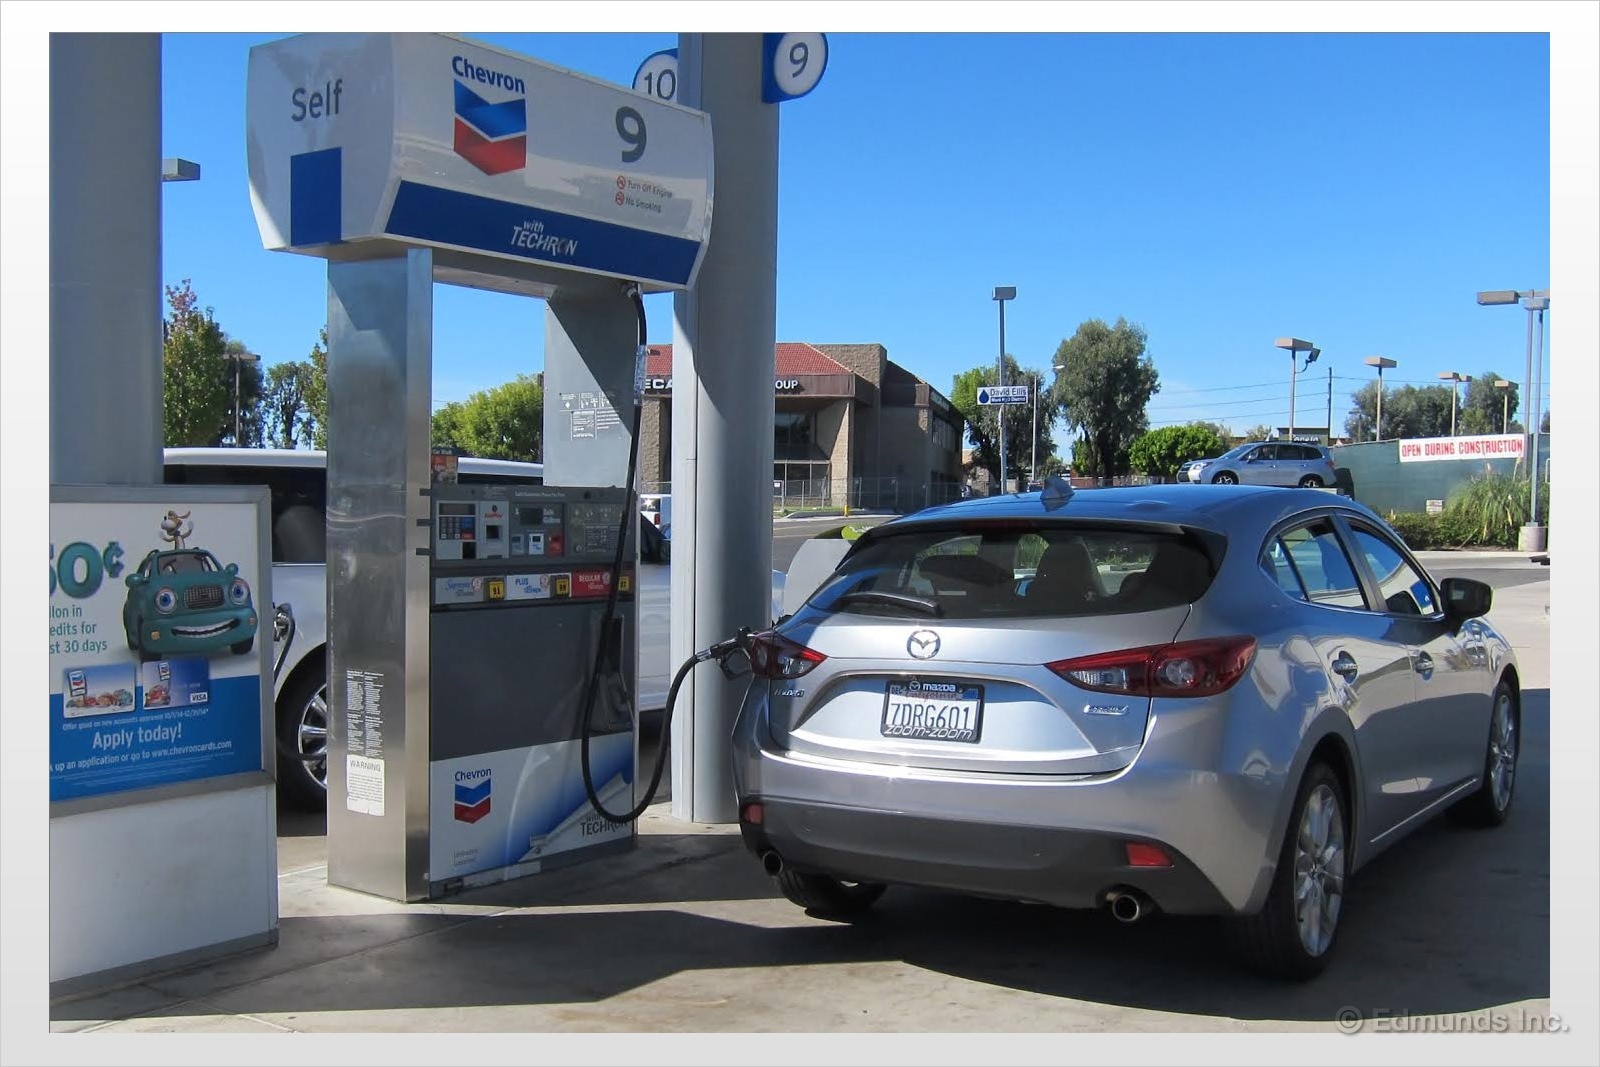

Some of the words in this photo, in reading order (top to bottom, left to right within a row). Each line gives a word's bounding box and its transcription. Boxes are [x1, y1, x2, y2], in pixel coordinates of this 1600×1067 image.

[789, 42, 809, 78] 9
[452, 55, 526, 94] Chevron
[643, 68, 677, 101] 10
[291, 78, 343, 122] Self
[615, 106, 647, 163] 9
[625, 196, 635, 206] No
[523, 219, 545, 233] with
[511, 226, 578, 256] TECHRON
[990, 388, 1010, 396] David
[1012, 387, 1027, 396] Ellis
[1401, 444, 1422, 458] OPEN
[1425, 442, 1456, 457] DURING
[1458, 439, 1523, 455] CONSTRUCTION
[515, 577, 530, 586] PLUS
[578, 573, 601, 583] REGULAR
[72, 604, 82, 617] in
[50, 622, 78, 636] edits
[81, 621, 97, 634] for
[50, 641, 61, 654] st
[64, 639, 79, 653] 30
[82, 639, 108, 653] days
[923, 683, 956, 692] mazda
[191, 693, 207, 701] VISA
[891, 703, 970, 729] 7DRG601
[92, 729, 134, 751] Apply
[137, 722, 182, 744] today!
[884, 725, 972, 739] zoom-zoom
[55, 763, 65, 773] up
[66, 761, 77, 770] an
[78, 755, 120, 769] application
[121, 753, 130, 762] or
[131, 752, 141, 762] go
[142, 750, 150, 760] to
[152, 741, 232, 758] www.chevroncards.com
[350, 760, 381, 773] WARNING
[454, 768, 492, 782] Chevron
